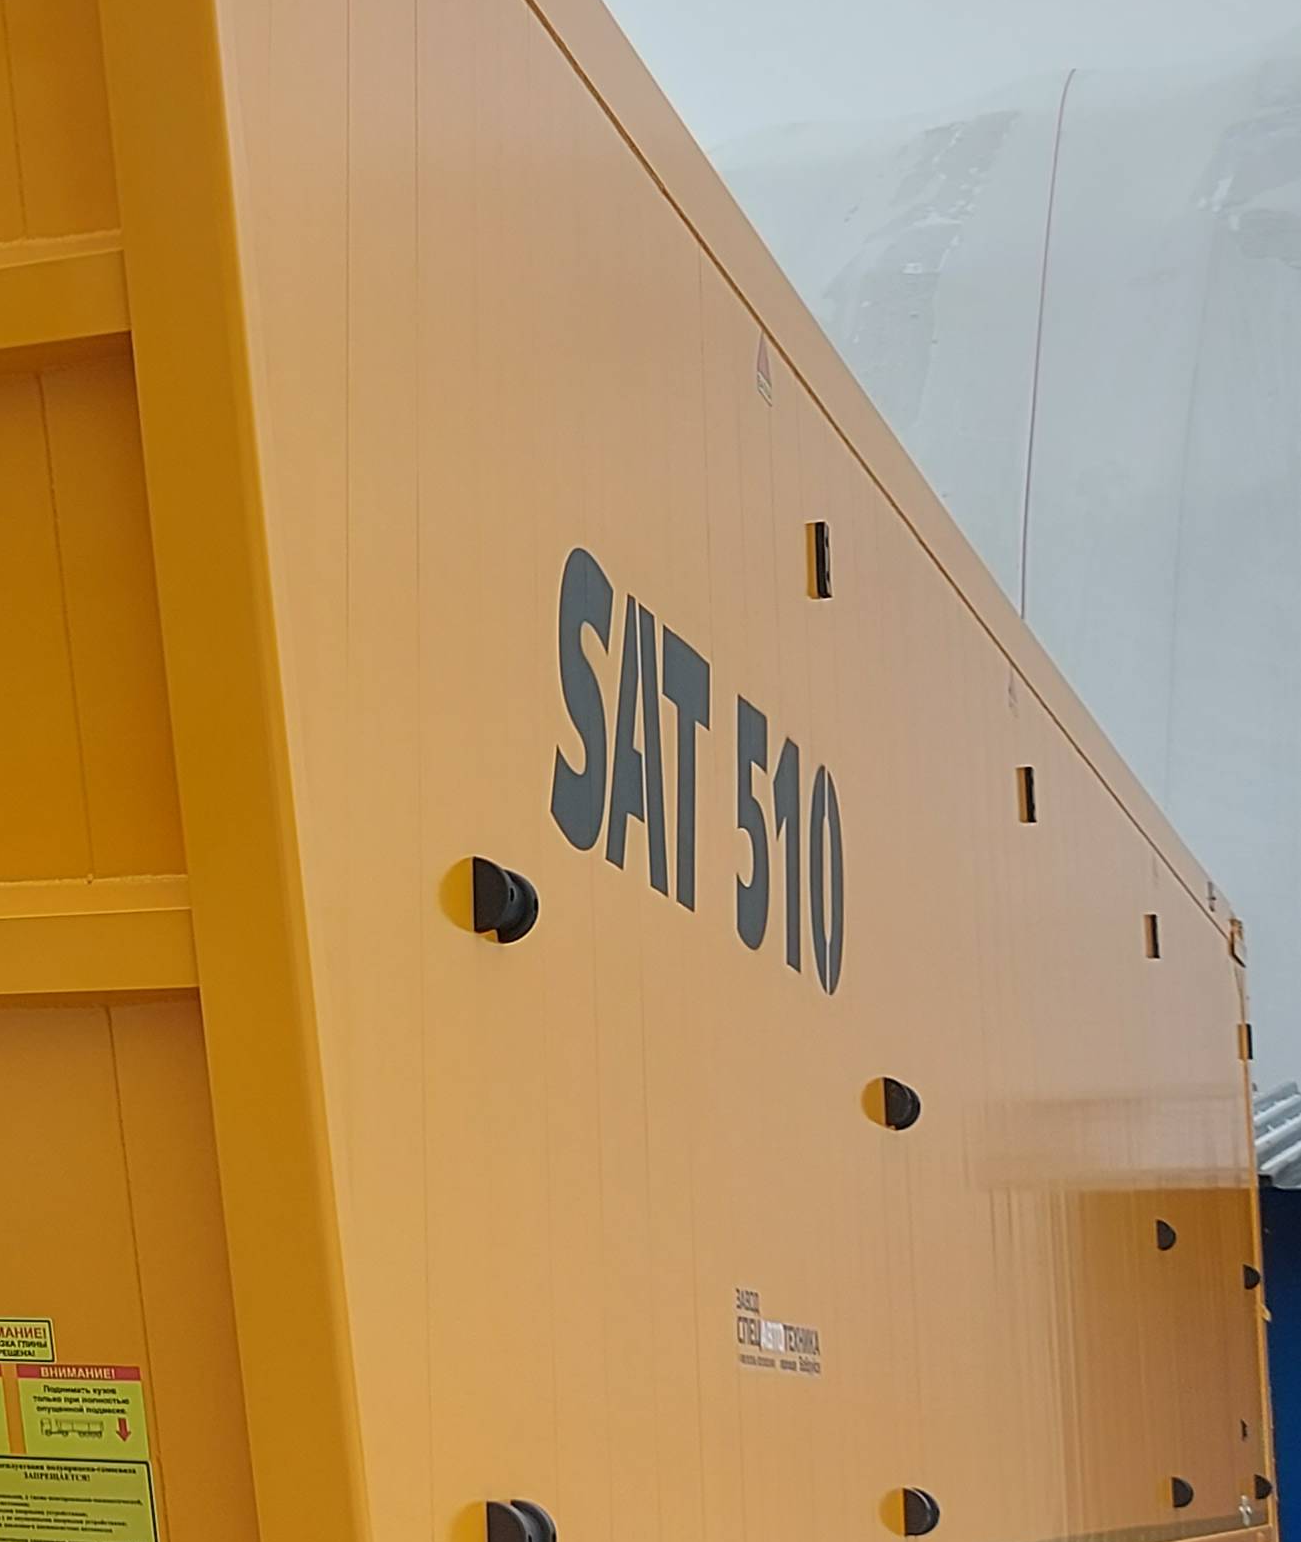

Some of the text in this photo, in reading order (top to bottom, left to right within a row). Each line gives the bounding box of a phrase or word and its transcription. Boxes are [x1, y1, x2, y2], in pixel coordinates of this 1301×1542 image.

[550, 546, 845, 996] SAT 510
[17, 1340, 48, 1350] ГЛИНЫ
[41, 1366, 115, 1379] ВНИМАНИЕ!
